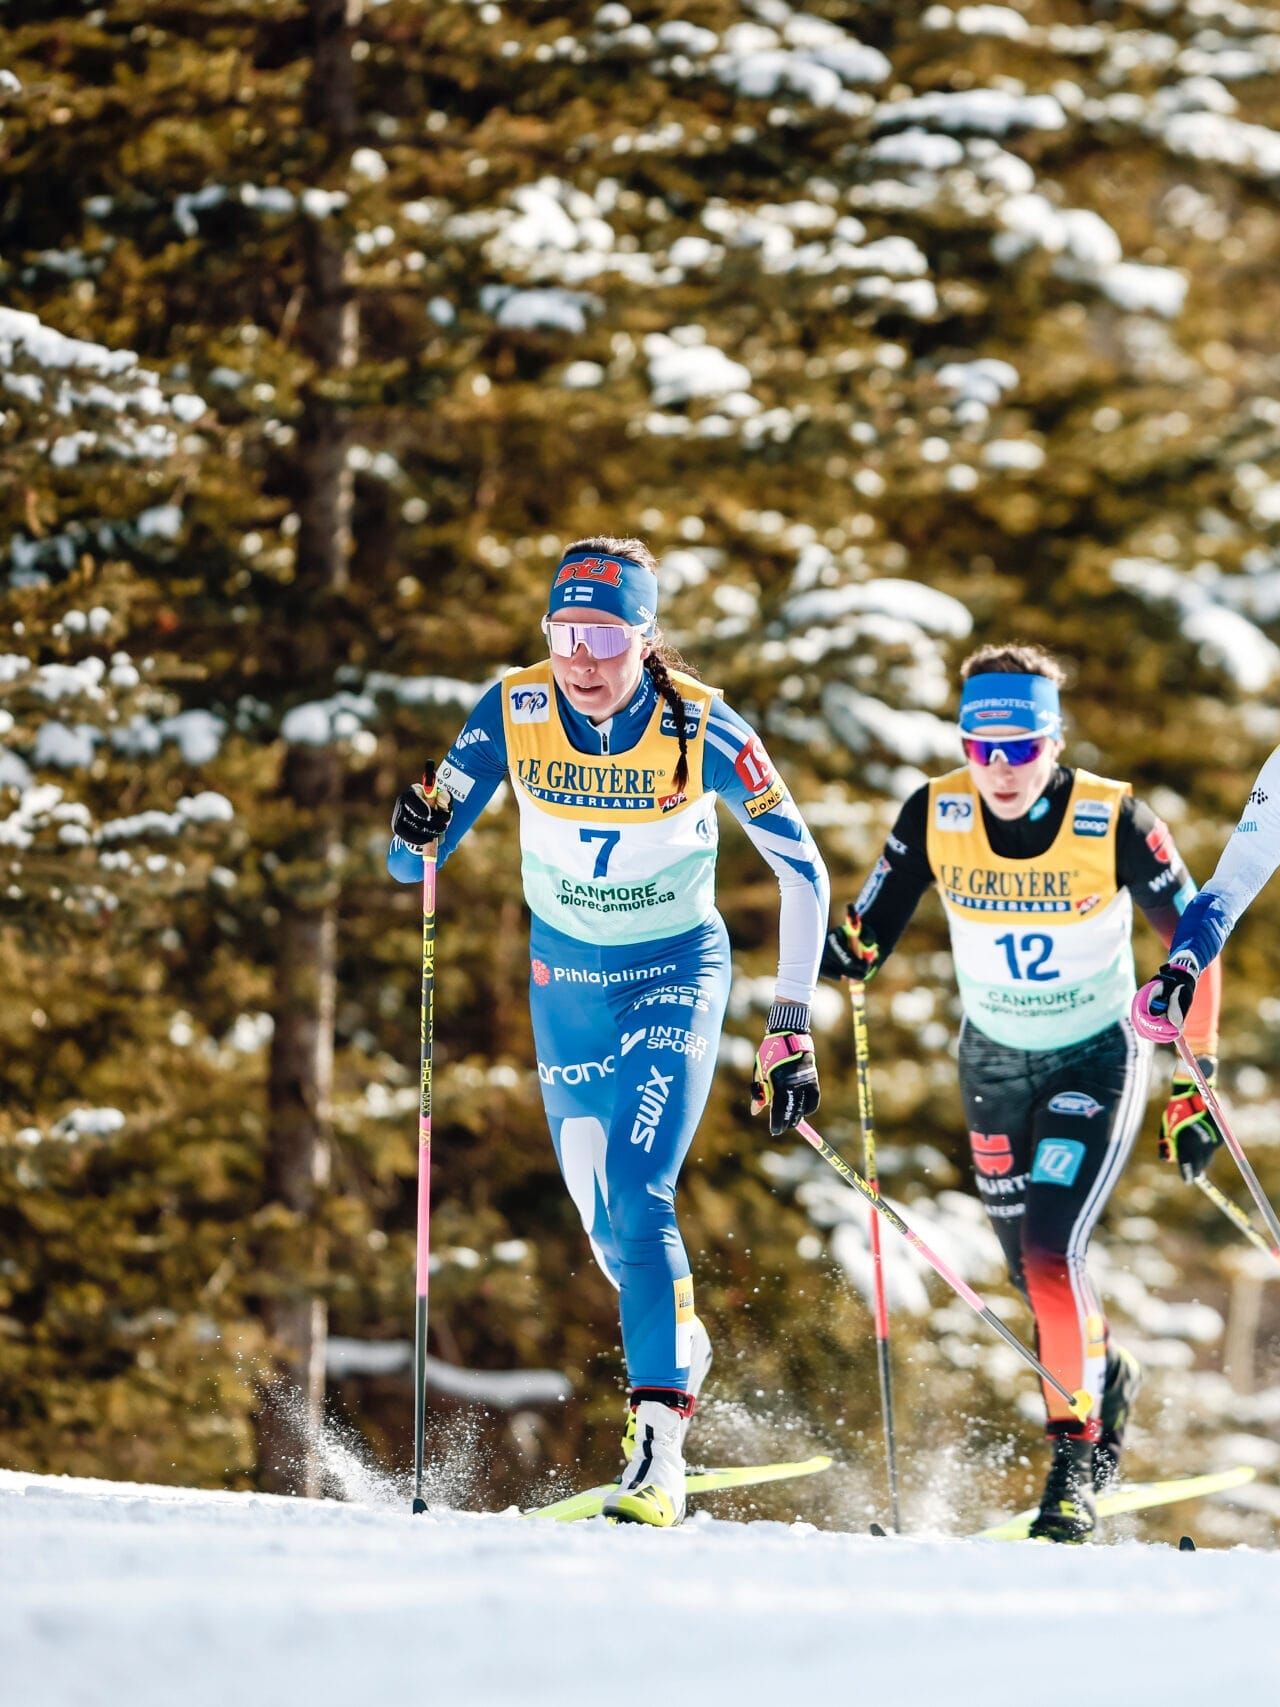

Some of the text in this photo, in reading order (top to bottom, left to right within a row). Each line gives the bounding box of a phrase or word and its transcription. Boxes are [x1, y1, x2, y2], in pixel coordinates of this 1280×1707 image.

[518, 759, 541, 786] LE
[1074, 819, 1108, 833] coop
[579, 828, 621, 879] 7
[561, 879, 658, 902] CANMORE
[941, 864, 963, 892] LE
[556, 889, 676, 913] plorecanmore.ca
[995, 932, 1061, 982] 12
[633, 993, 710, 1012] TYRES
[646, 1037, 706, 1062] SPORT
[650, 1025, 709, 1052] INTER
